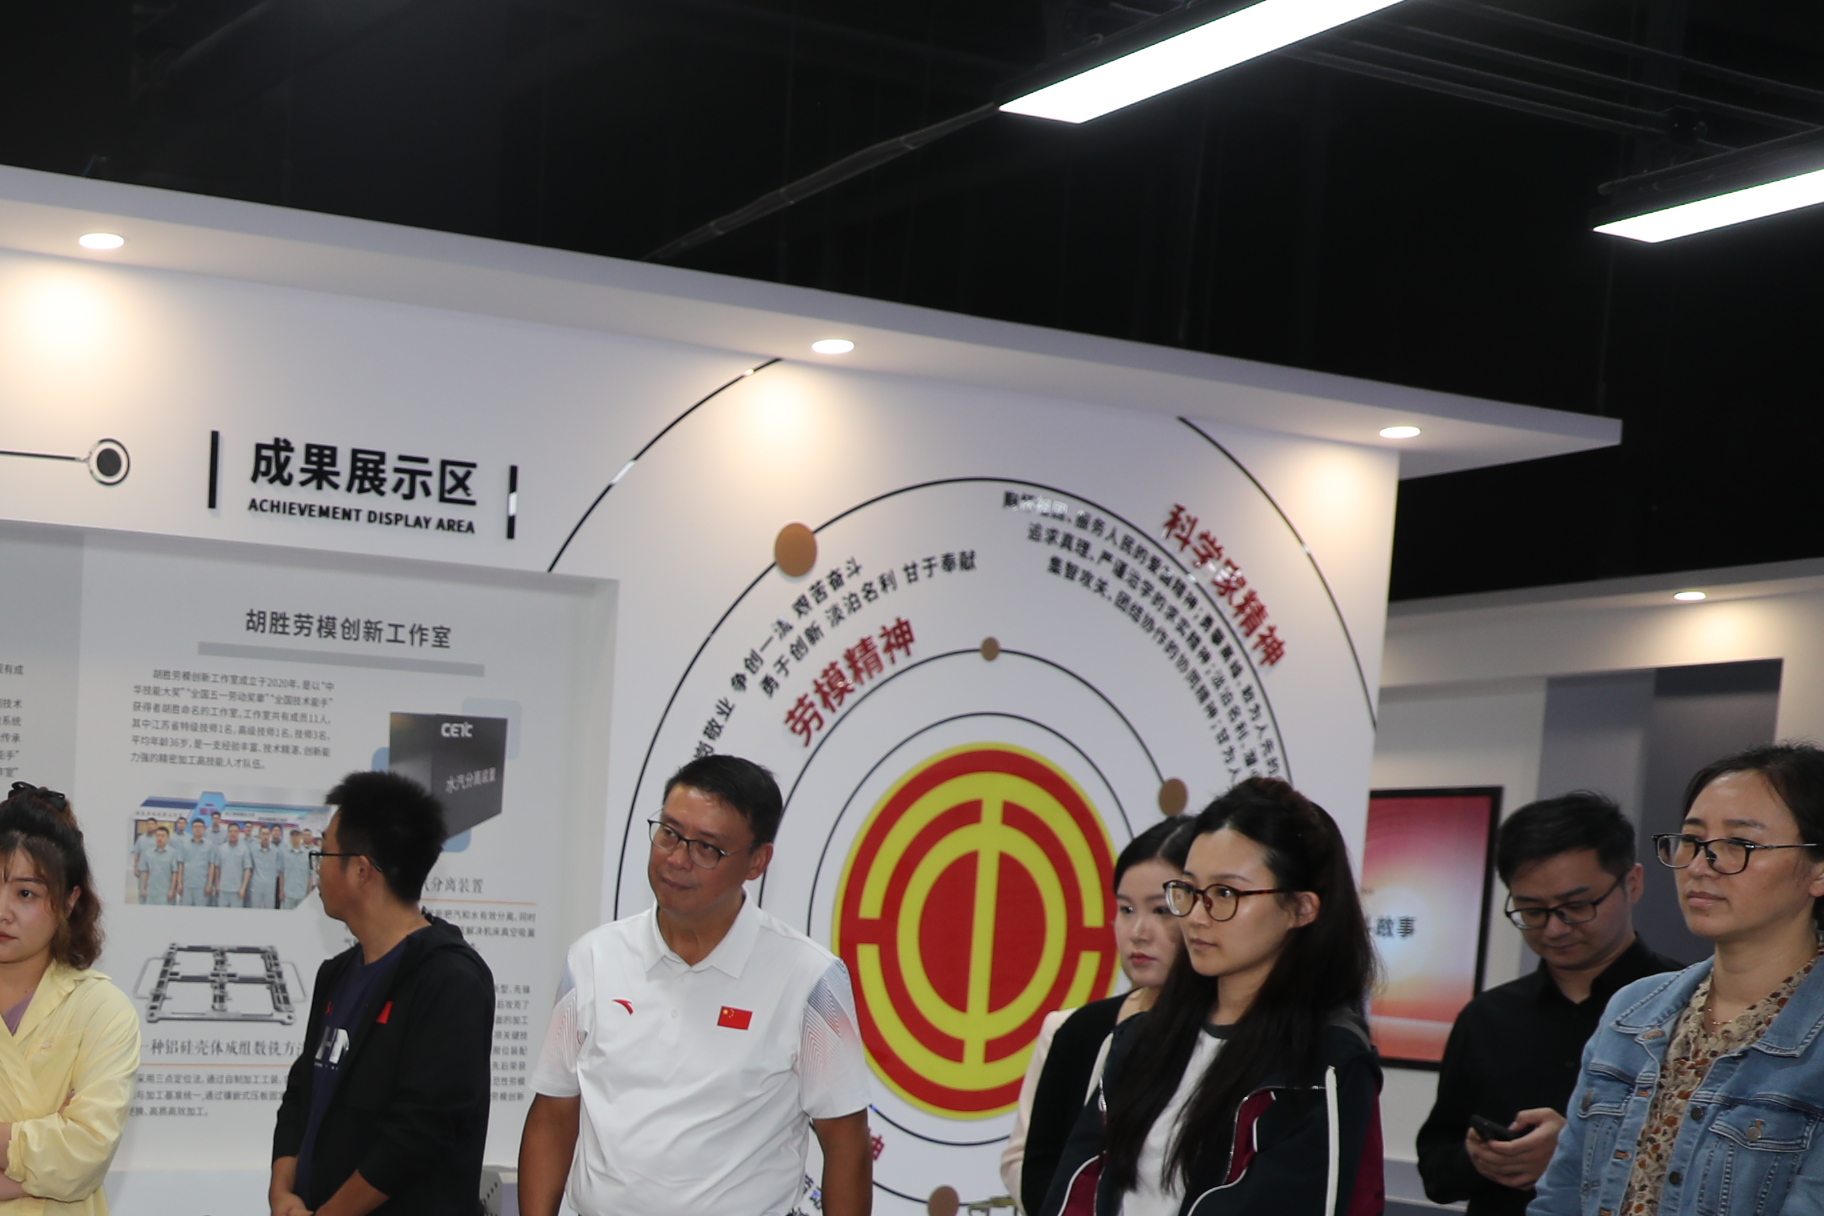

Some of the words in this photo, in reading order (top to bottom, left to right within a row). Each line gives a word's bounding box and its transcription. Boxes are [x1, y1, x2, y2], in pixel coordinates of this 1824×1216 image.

[250, 436, 478, 506] 成果展示区
[248, 498, 362, 524] ACHIEVEMENT
[366, 510, 432, 531] DISPLAY
[435, 516, 476, 535] AREA
[792, 556, 863, 619] 艰苦奋斗
[1162, 502, 1287, 668] 科学家精神
[245, 609, 452, 649] 胡胜劳模创新工作室
[758, 620, 826, 698] 勇于创新
[824, 569, 899, 628] 淡泊名利
[902, 549, 977, 585] 甘于奉献
[783, 616, 916, 748] 劳模精神
